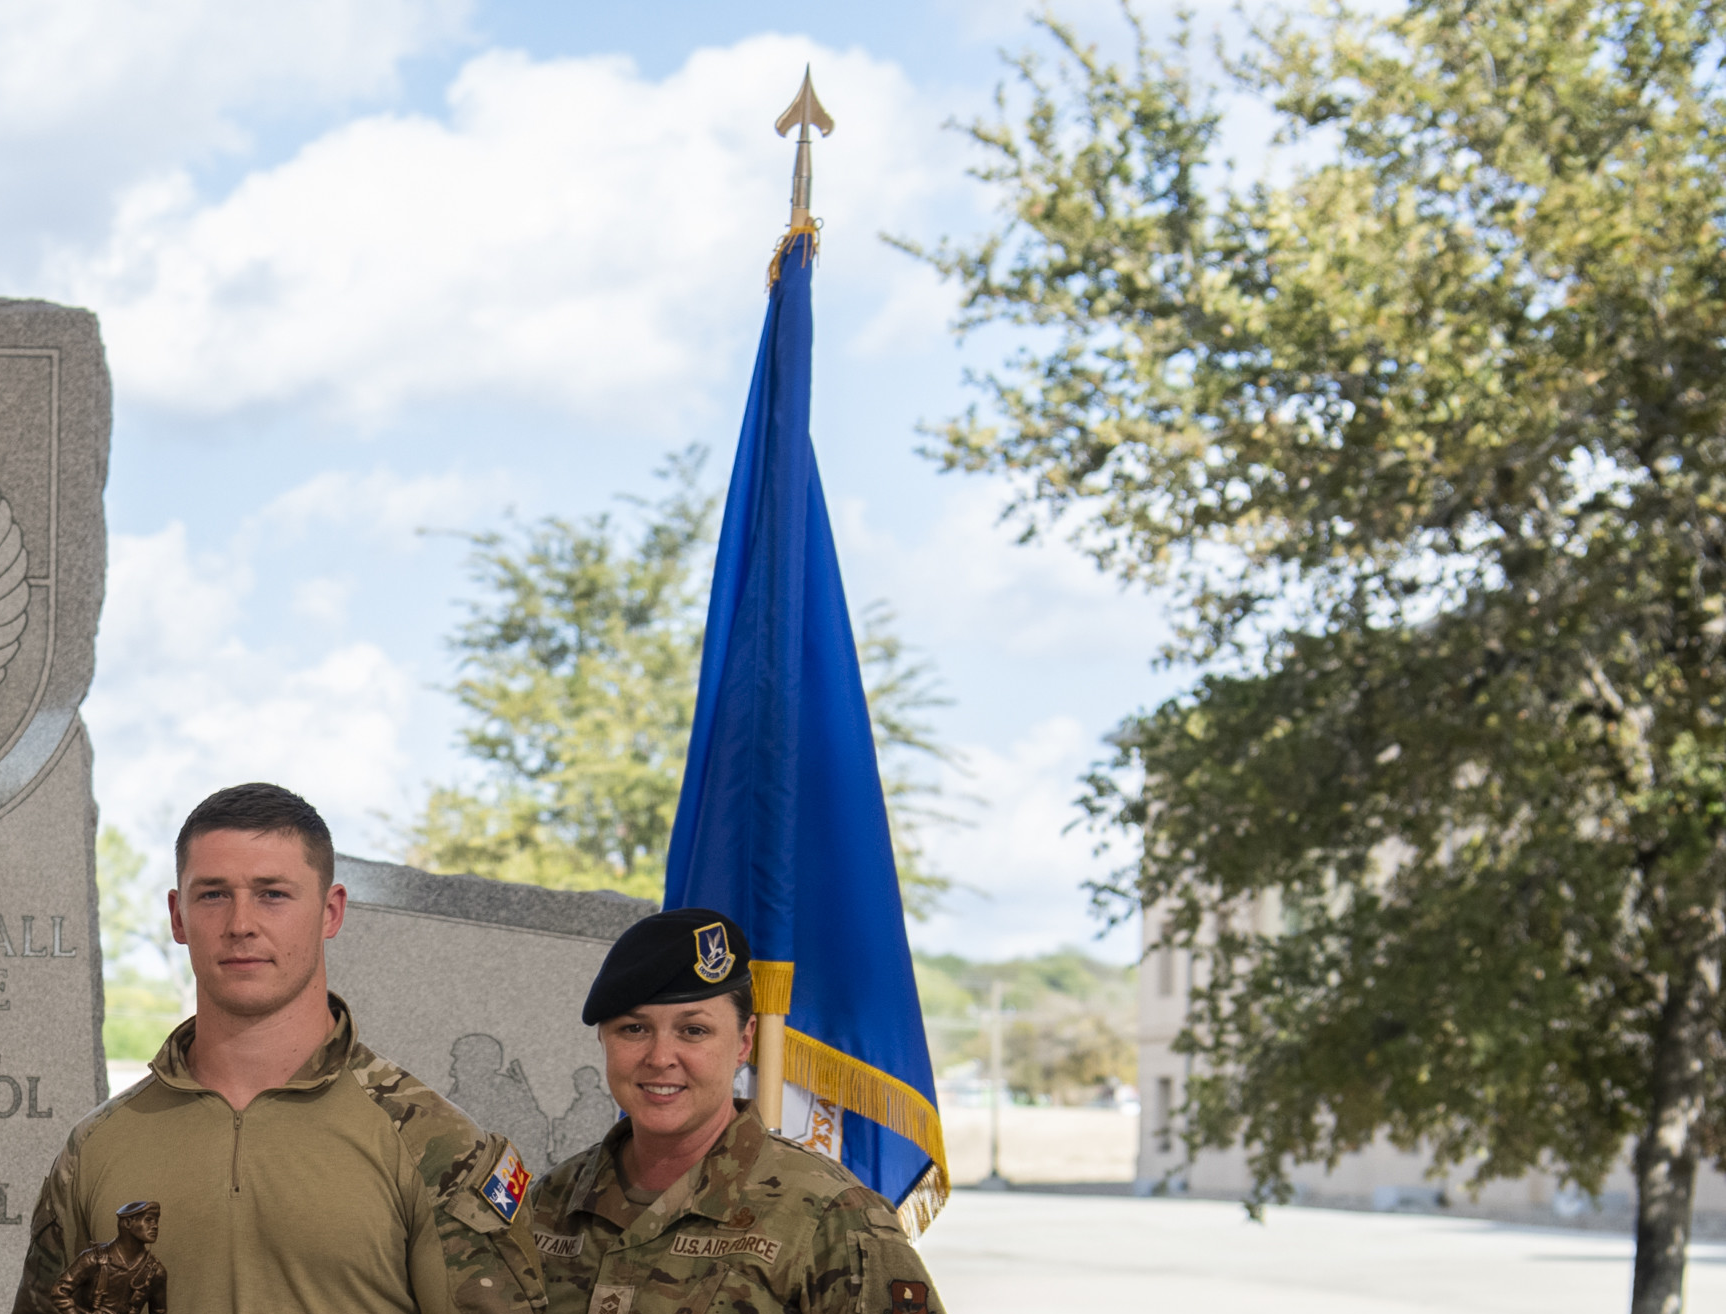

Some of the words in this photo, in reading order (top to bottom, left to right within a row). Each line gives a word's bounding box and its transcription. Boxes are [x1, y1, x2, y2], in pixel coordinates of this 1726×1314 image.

[675, 1236, 700, 1255] U.S.
[703, 1238, 727, 1256] AIR
[727, 1236, 778, 1261] FORCE
